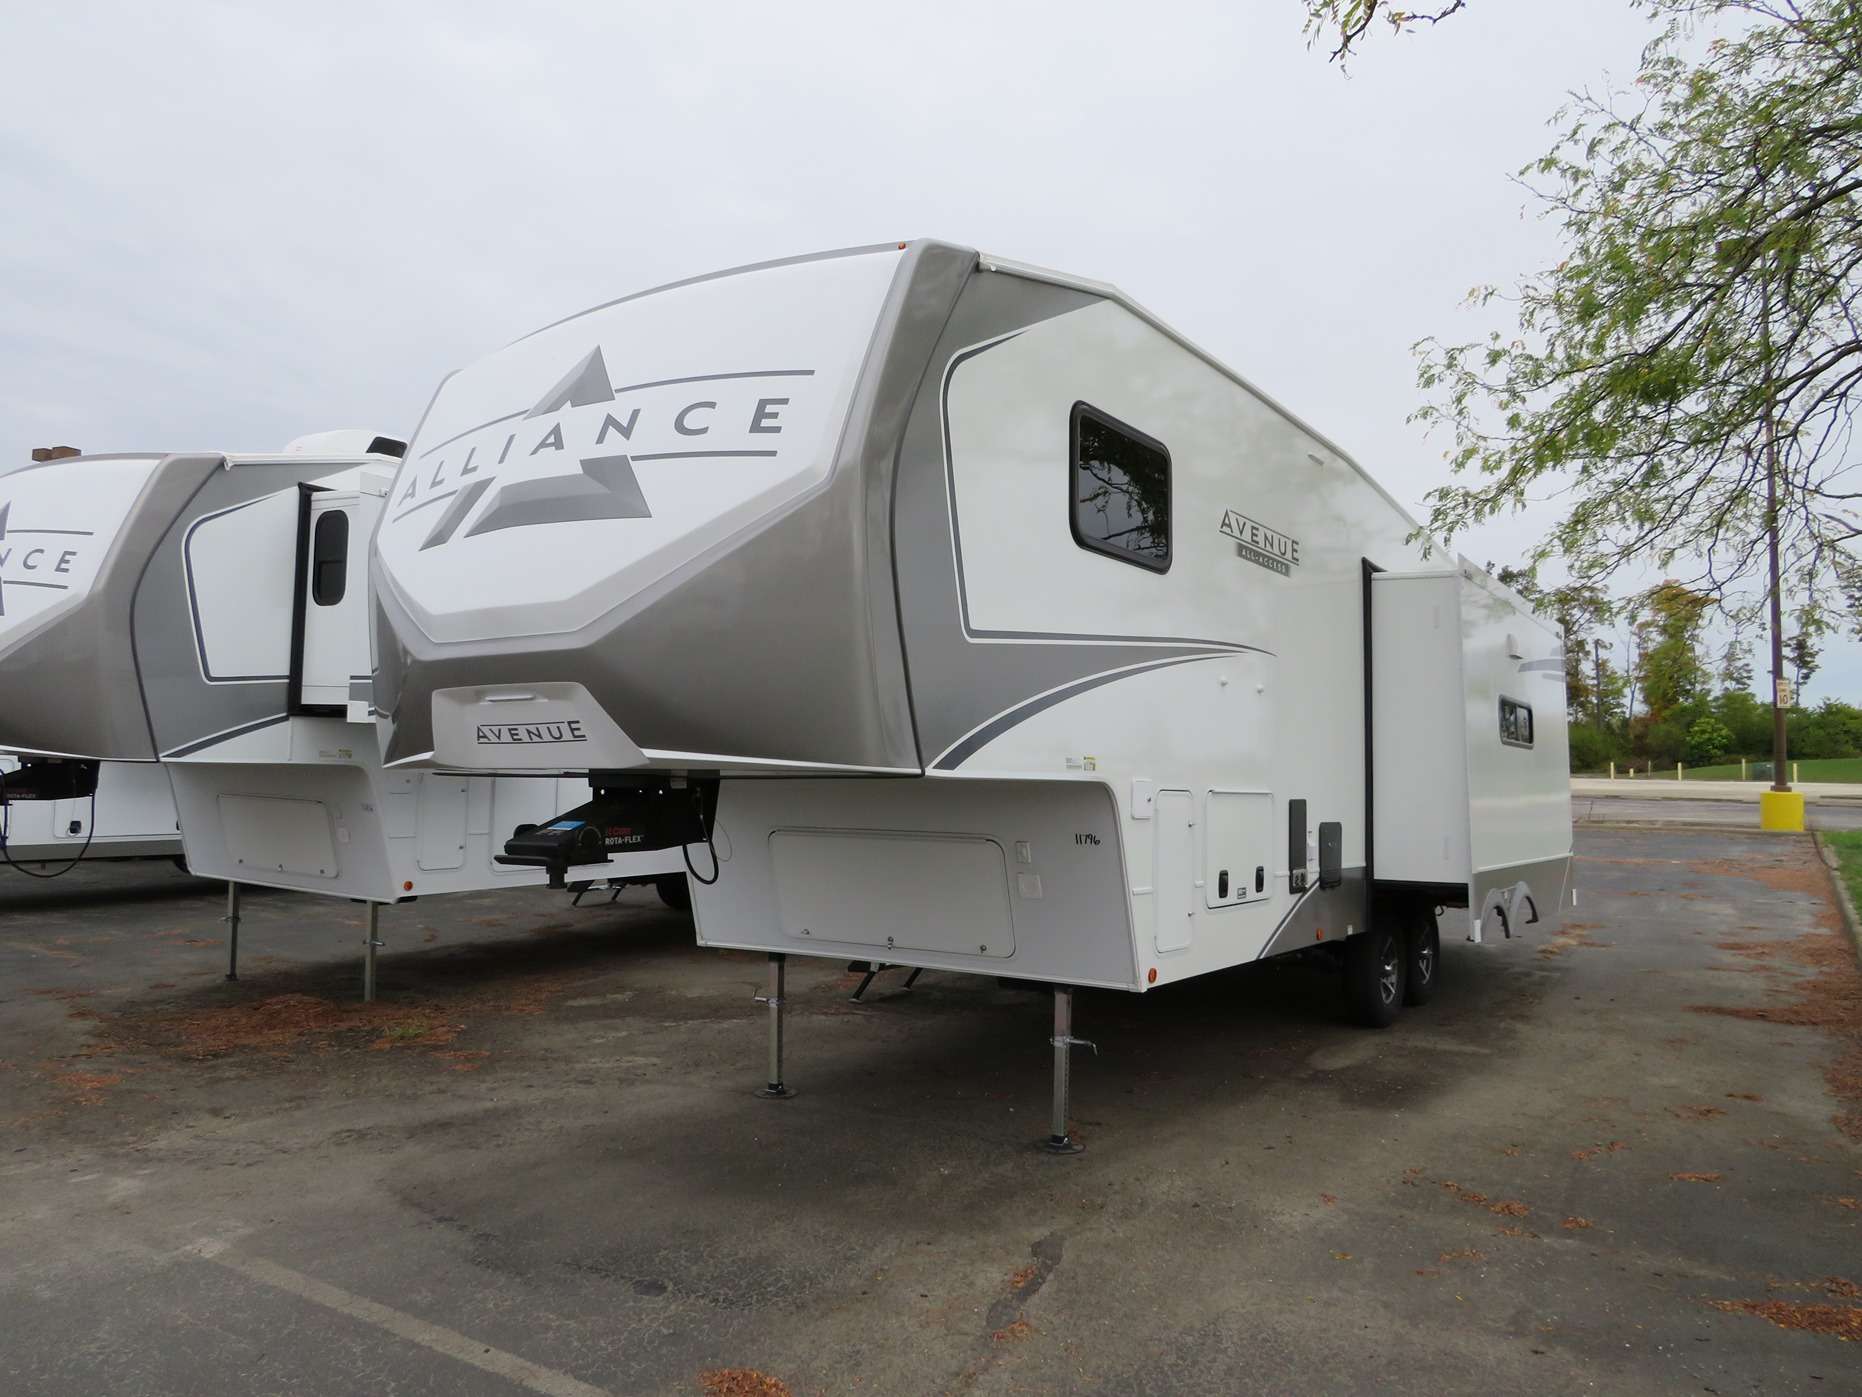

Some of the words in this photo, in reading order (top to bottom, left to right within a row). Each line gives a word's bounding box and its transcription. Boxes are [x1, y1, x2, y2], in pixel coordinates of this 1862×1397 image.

[398, 397, 791, 507] ALLIANCE
[1220, 508, 1300, 563] AVENUE
[476, 720, 587, 742] AVENUE
[1075, 833, 1101, 846] 11796
